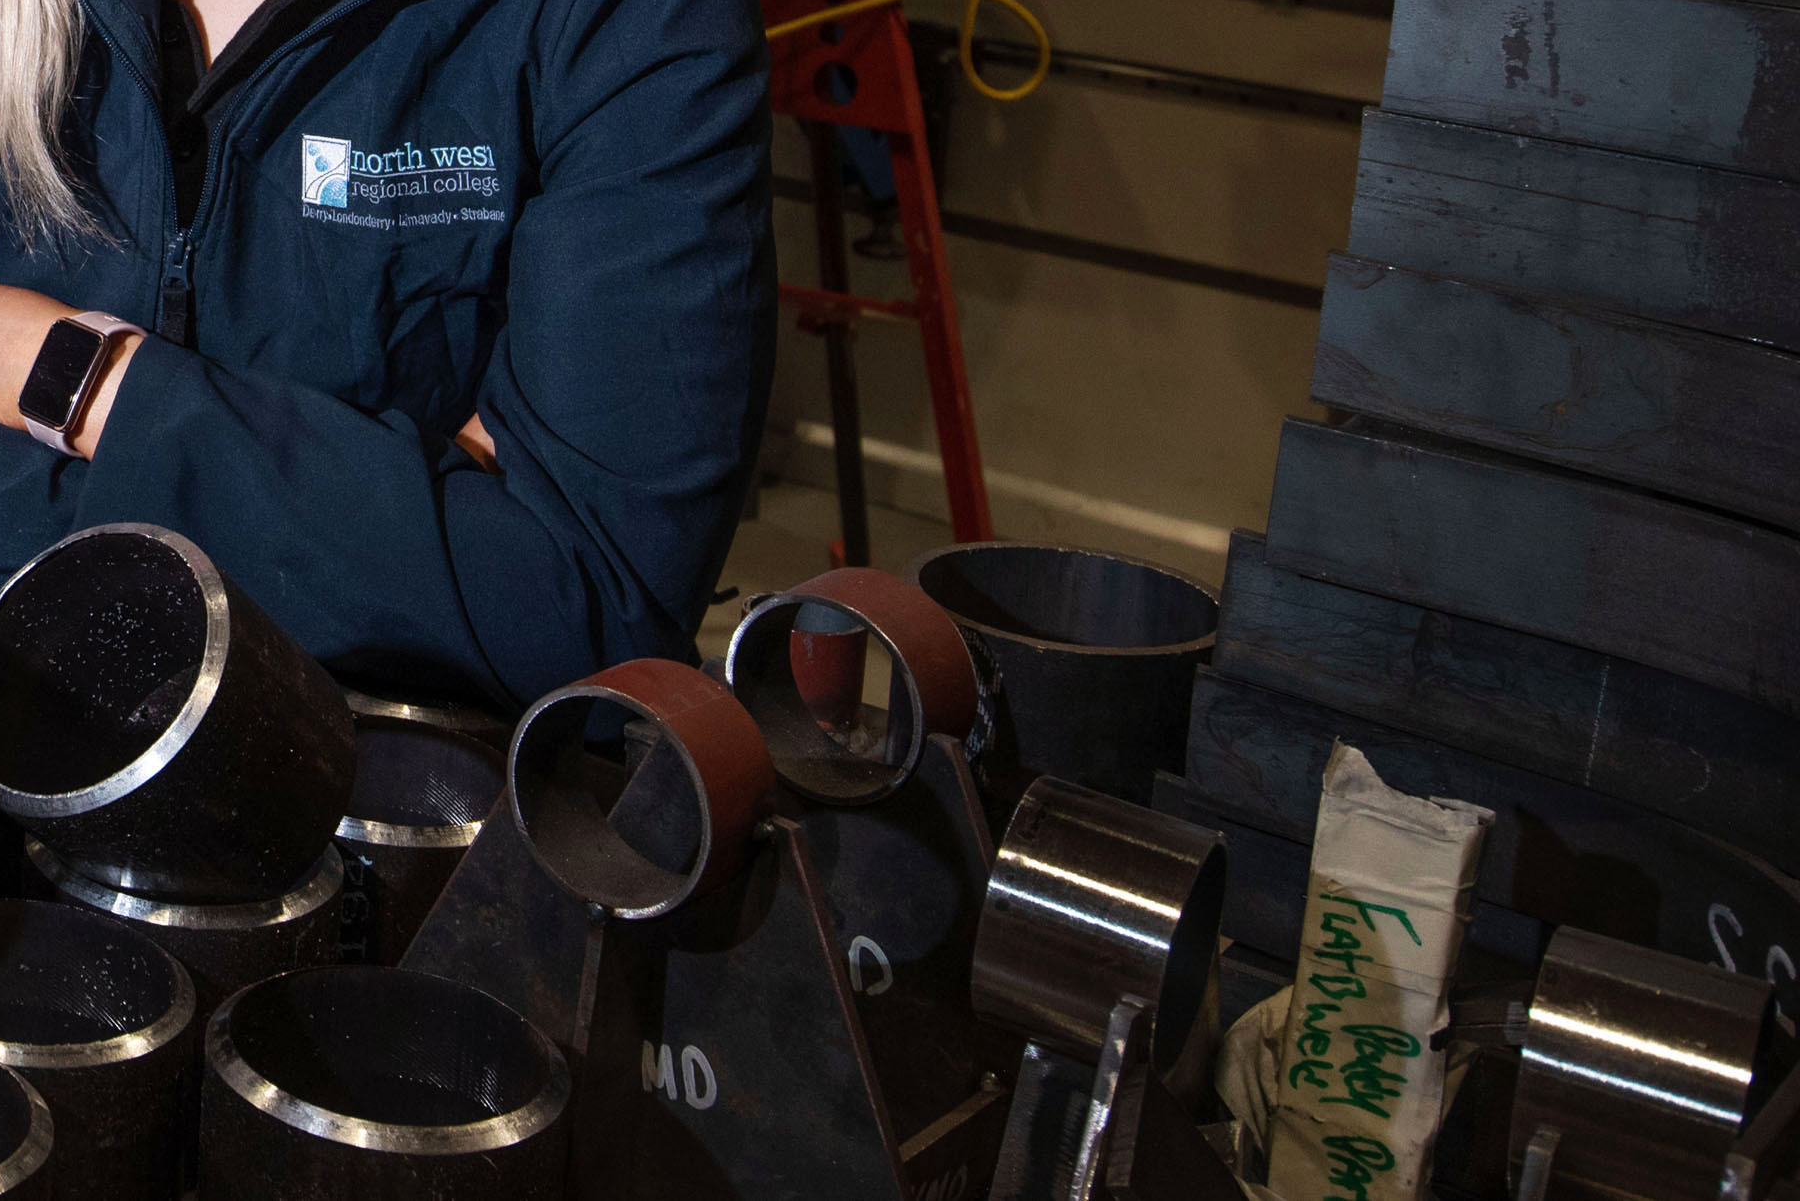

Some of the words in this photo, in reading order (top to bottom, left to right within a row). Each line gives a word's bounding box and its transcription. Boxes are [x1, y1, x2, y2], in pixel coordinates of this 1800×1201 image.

[351, 141, 427, 174] north
[351, 174, 430, 205] regional
[433, 171, 501, 197] college
[641, 1039, 718, 1111] MD
